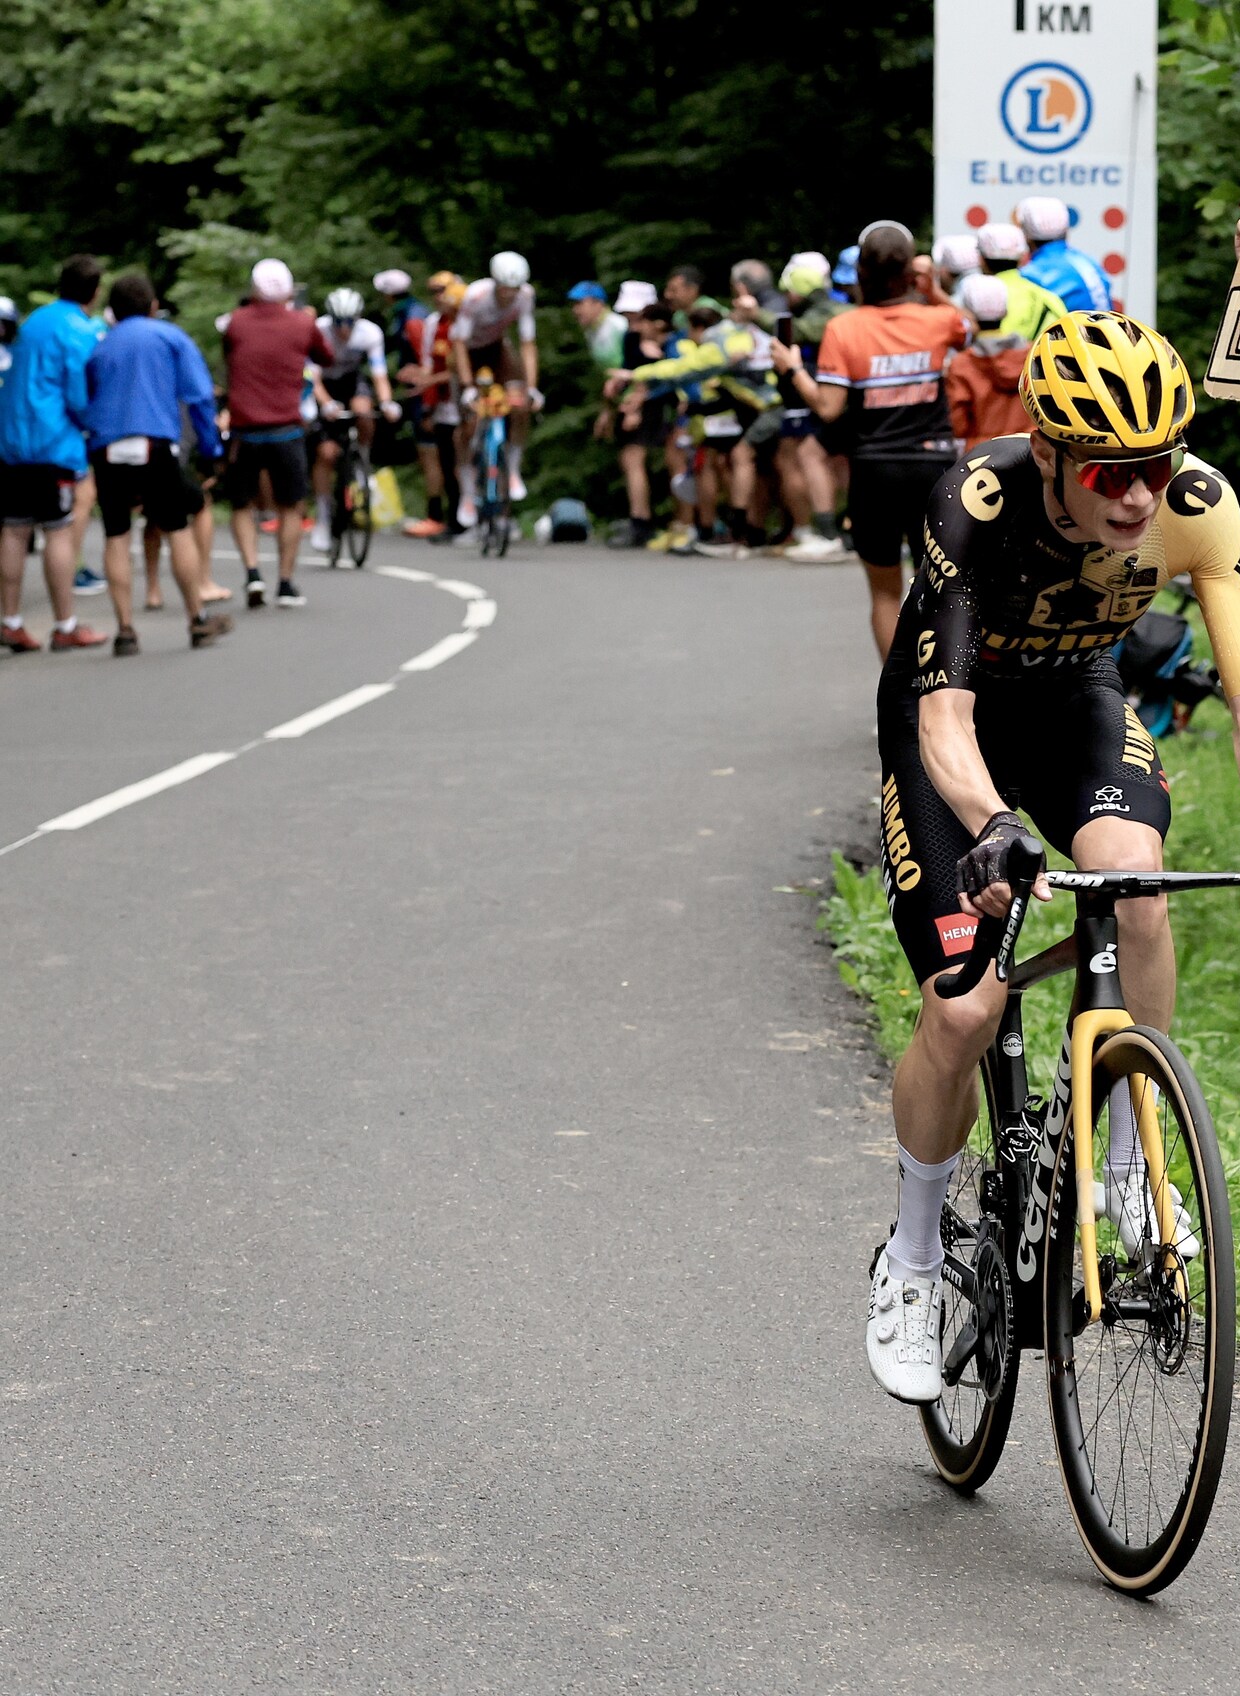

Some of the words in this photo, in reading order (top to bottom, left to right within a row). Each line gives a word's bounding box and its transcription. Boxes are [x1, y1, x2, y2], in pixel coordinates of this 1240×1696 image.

[1038, 5, 1092, 33] KM
[970, 160, 1122, 186] E.Leclerc
[1058, 431, 1109, 445] LAZER
[882, 773, 922, 891] JUMBO
[998, 896, 1023, 965] SRAM
[943, 1263, 963, 1288] AM
